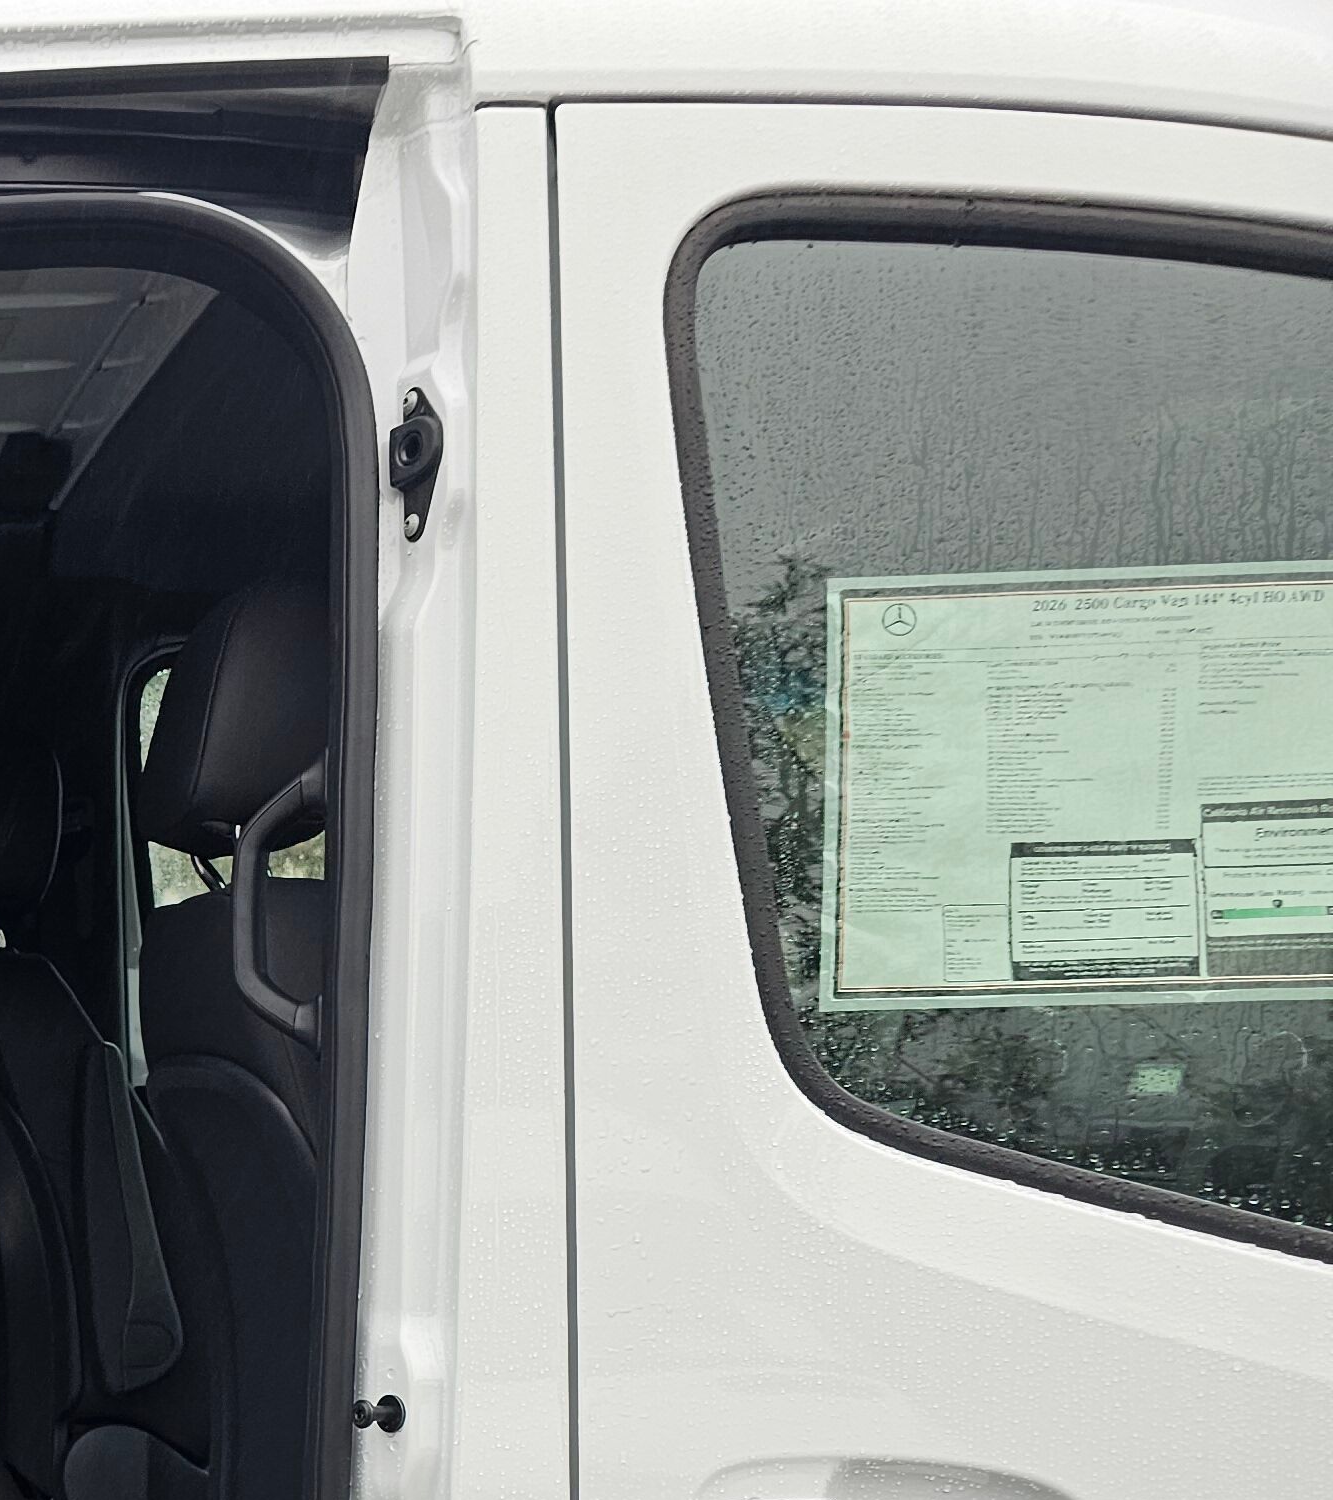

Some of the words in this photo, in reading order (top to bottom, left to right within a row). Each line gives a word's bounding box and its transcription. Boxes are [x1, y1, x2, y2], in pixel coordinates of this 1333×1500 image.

[1032, 599, 1067, 612] 2026
[1074, 598, 1110, 611] 2500
[1113, 596, 1157, 611] Cargo
[1160, 595, 1189, 608] Van
[1262, 590, 1287, 604] HO
[1288, 589, 1325, 604] AWD
